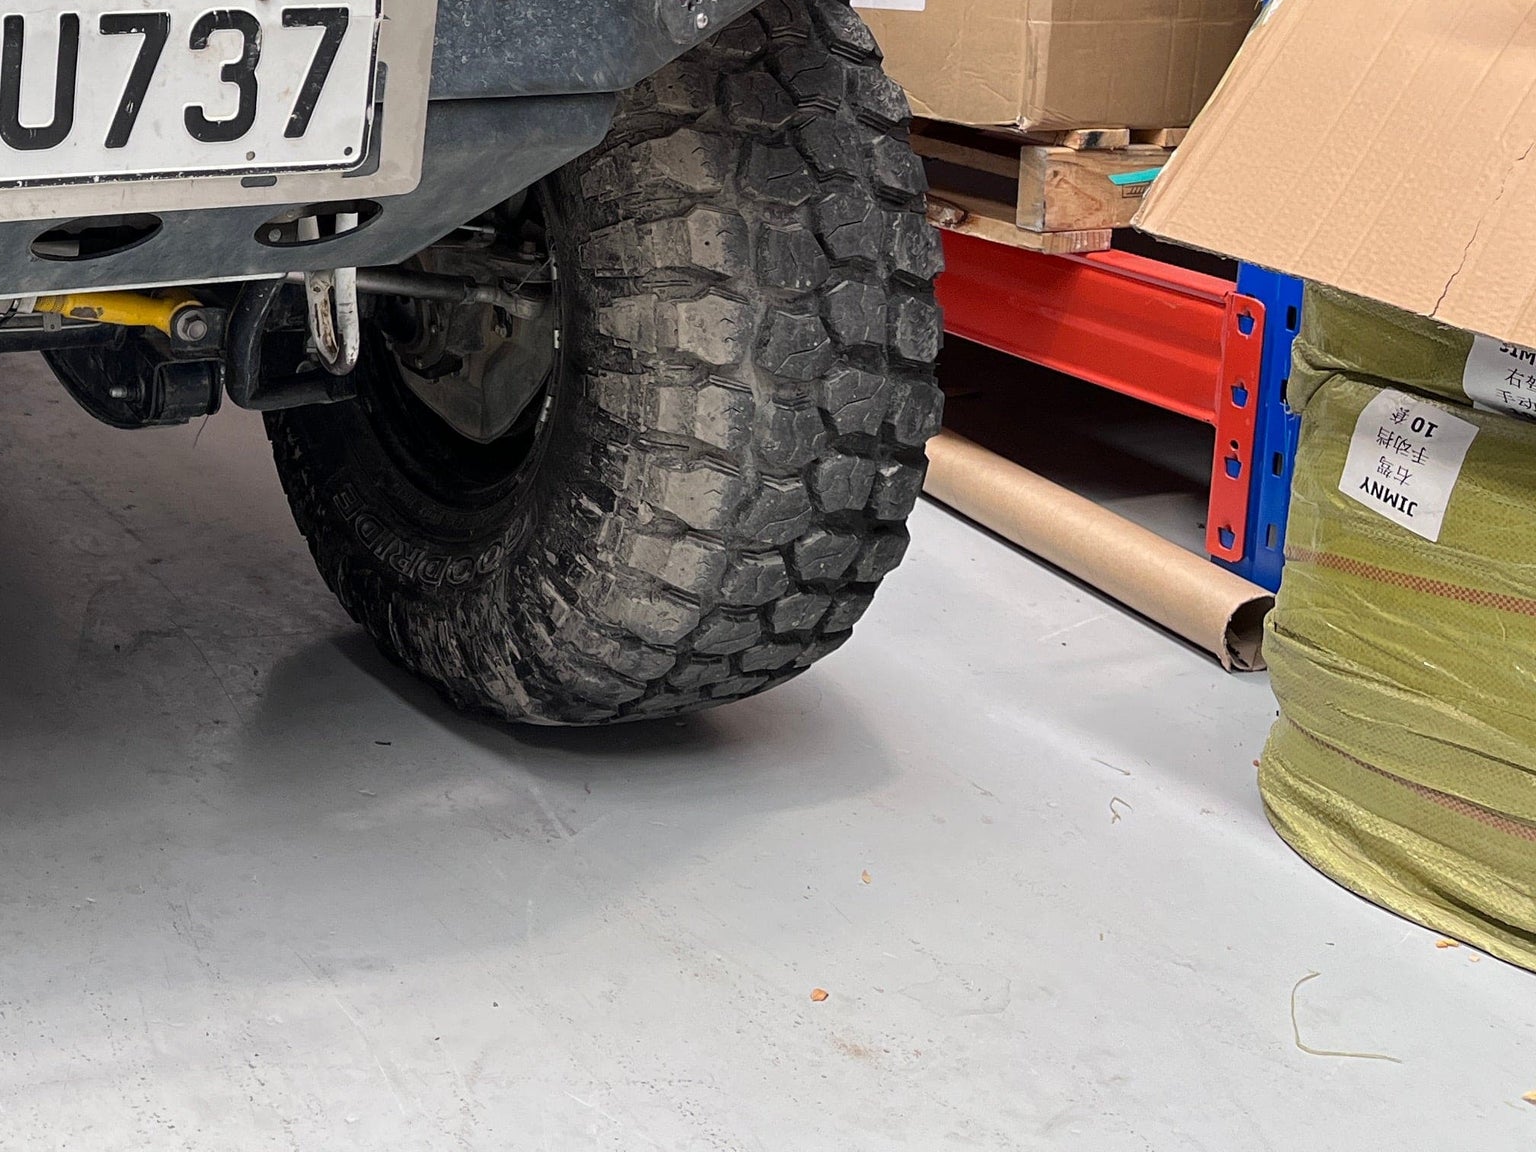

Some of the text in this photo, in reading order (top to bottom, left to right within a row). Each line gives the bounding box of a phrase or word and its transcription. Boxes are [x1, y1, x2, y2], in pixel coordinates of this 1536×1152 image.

[1496, 388, 1536, 412] 手动
[1389, 407, 1439, 439] 10 套
[1376, 425, 1430, 466] 手动挡
[1376, 455, 1414, 486] 右驾
[1359, 475, 1419, 518] JIMNY
